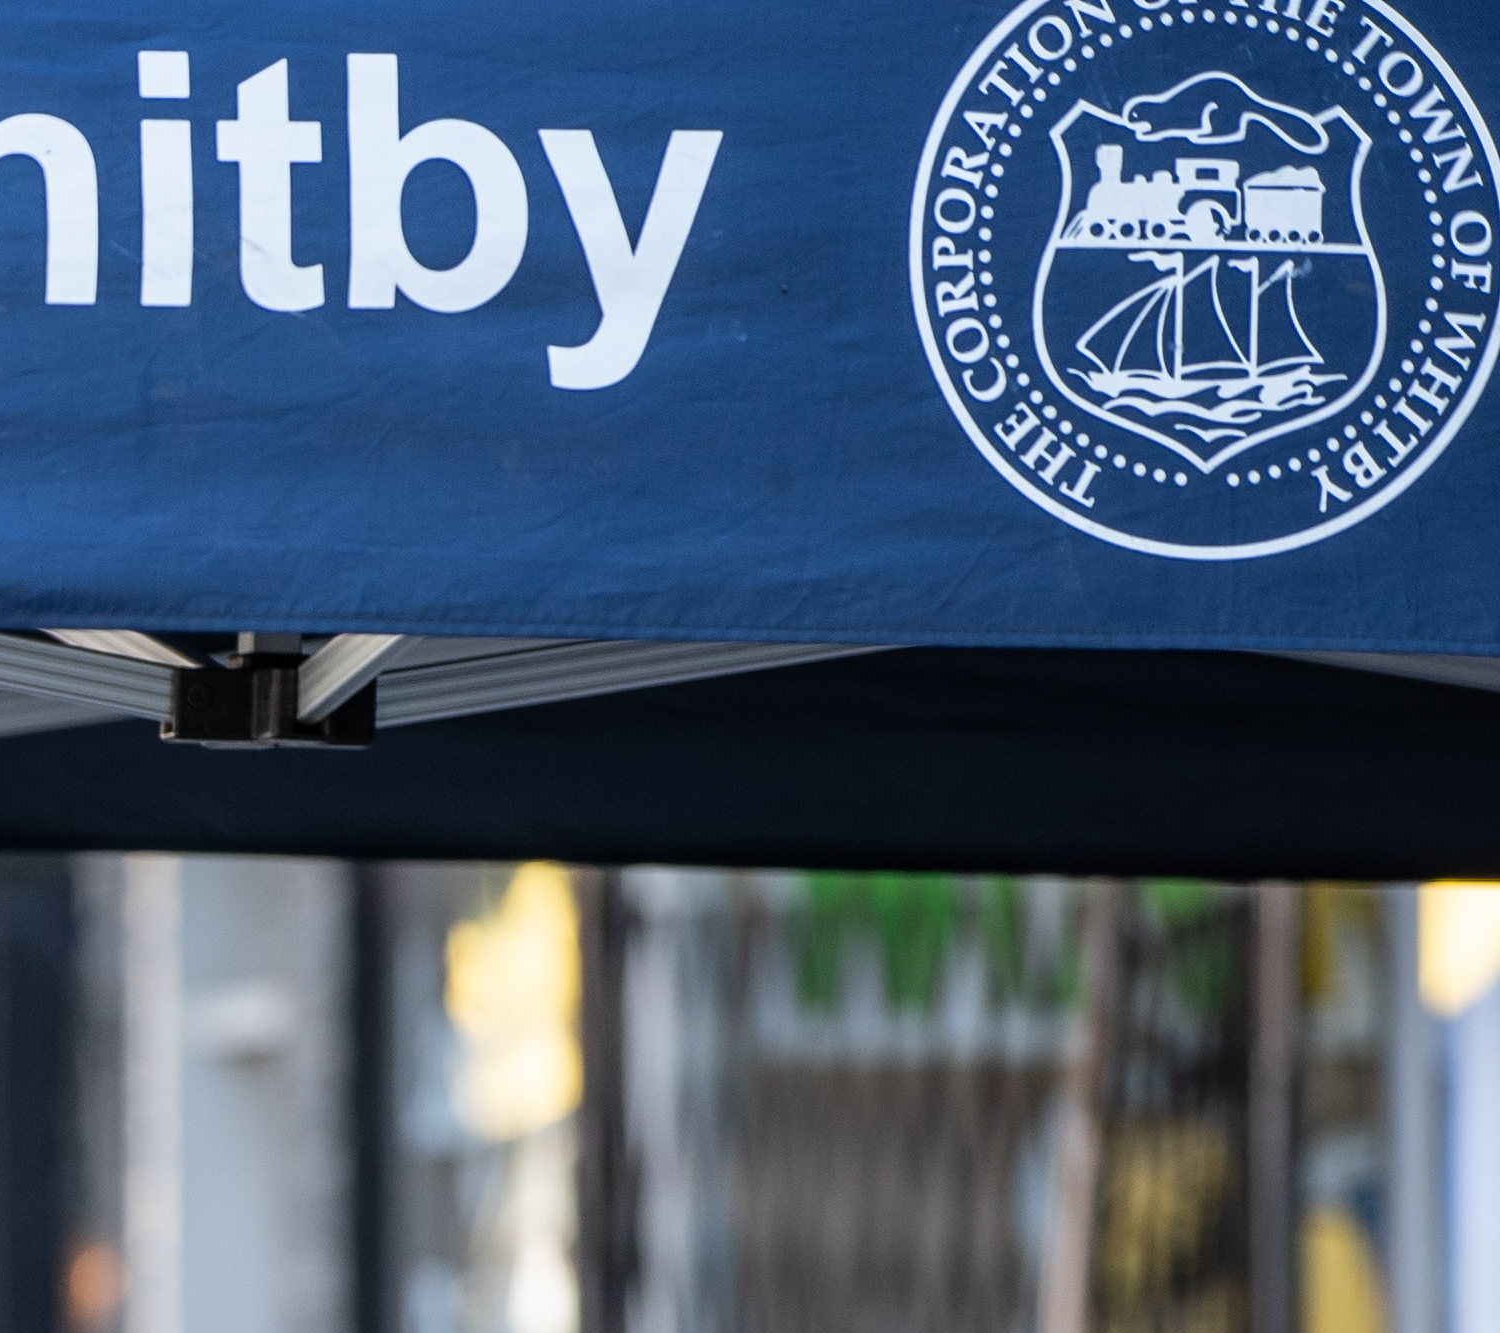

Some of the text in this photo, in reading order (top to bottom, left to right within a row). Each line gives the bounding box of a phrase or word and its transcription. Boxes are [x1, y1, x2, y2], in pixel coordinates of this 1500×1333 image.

[932, 0, 1493, 513] THE CORPORATION TOWN OF WHITBY
